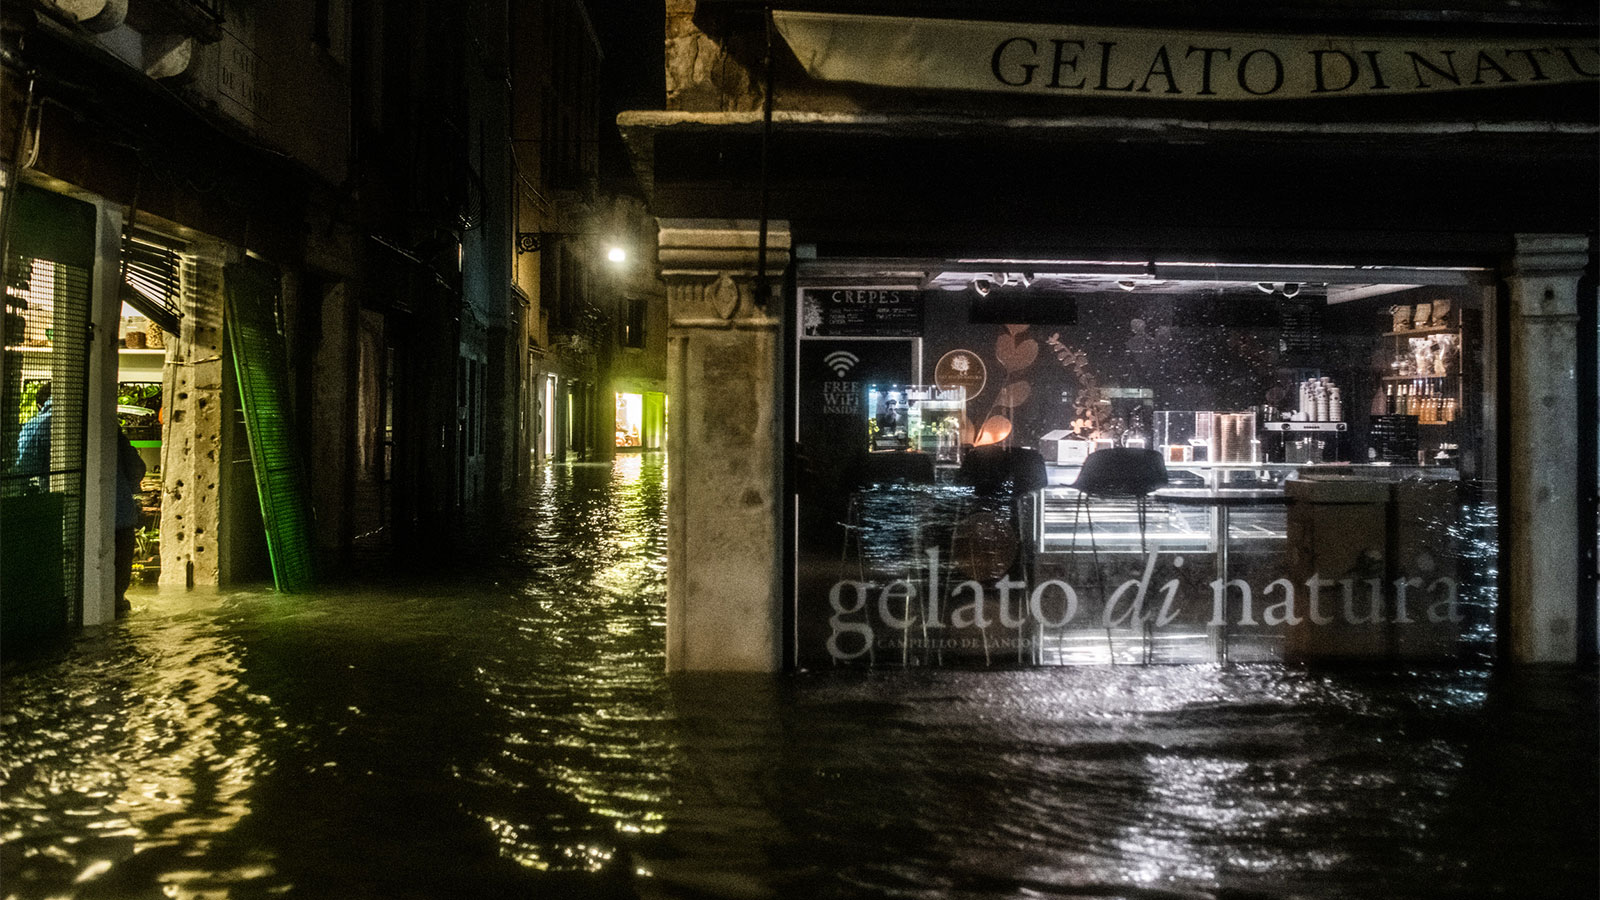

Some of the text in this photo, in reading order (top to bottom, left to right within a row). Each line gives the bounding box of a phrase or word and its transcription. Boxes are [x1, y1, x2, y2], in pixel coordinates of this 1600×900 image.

[990, 37, 1284, 96] GELATO
[1308, 48, 1392, 94] DI
[831, 290, 900, 304] CREPES
[823, 381, 859, 392] FREE
[826, 543, 1465, 660] gelato di natura
